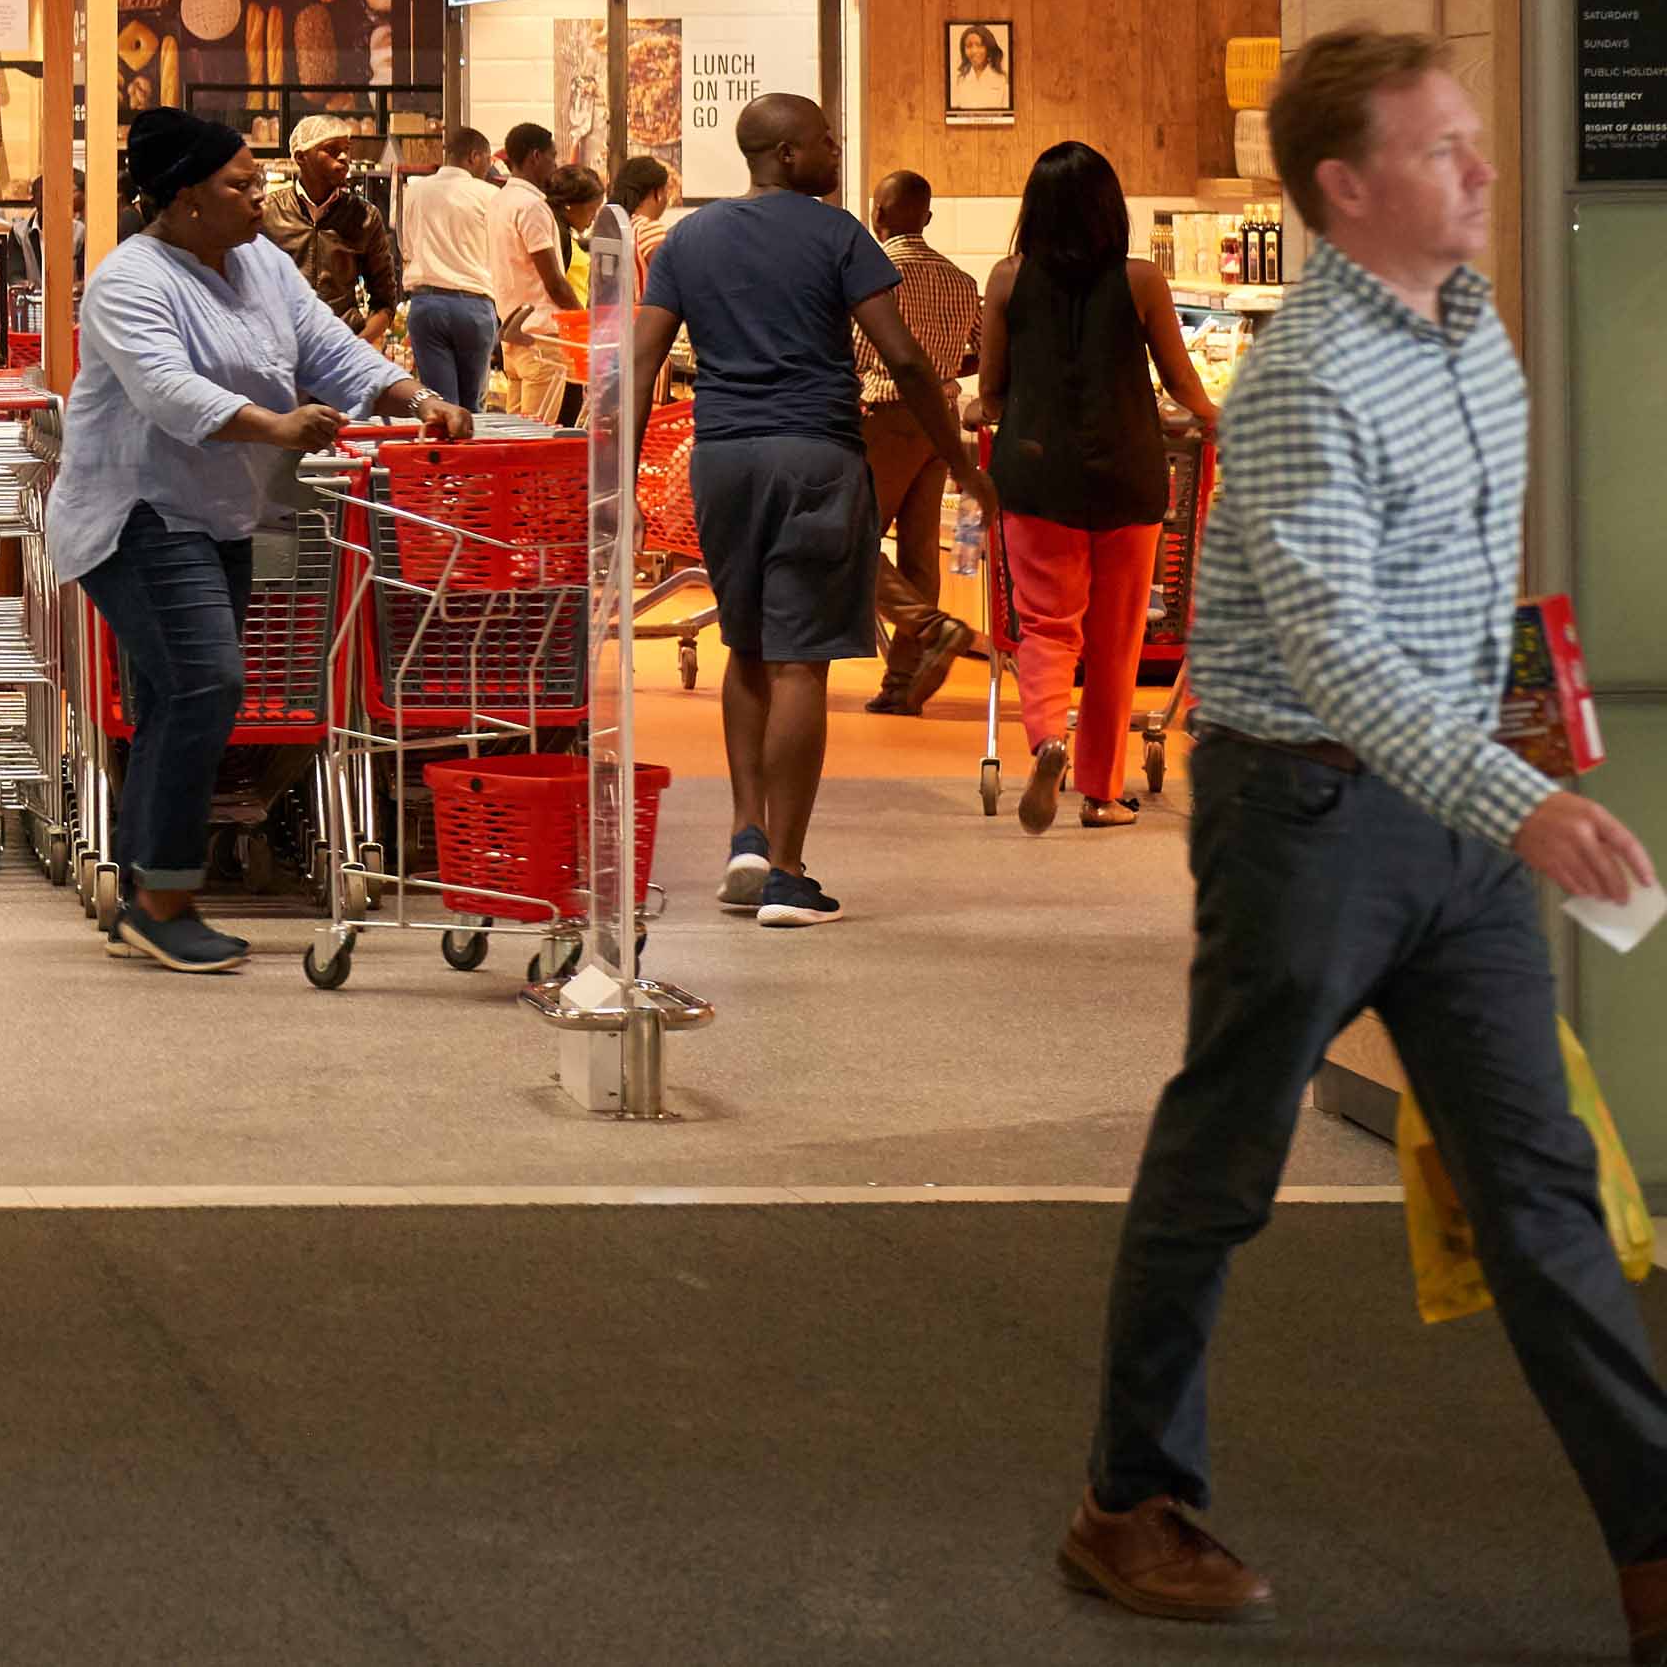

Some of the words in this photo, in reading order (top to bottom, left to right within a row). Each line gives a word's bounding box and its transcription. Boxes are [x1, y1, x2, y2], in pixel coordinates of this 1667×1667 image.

[1583, 11, 1640, 21] SATURDAYS
[1584, 39, 1630, 48] SUNDAYS
[693, 53, 755, 75] LUNCH
[1584, 67, 1620, 77] PUBLIC
[693, 80, 718, 102] ON
[726, 80, 761, 102] THE
[1584, 92, 1643, 101] EMERGENCY
[1584, 100, 1626, 109] NUMBER
[693, 106, 718, 128] GO
[1585, 124, 1614, 132] RIGHT
[1615, 124, 1628, 132] OF
